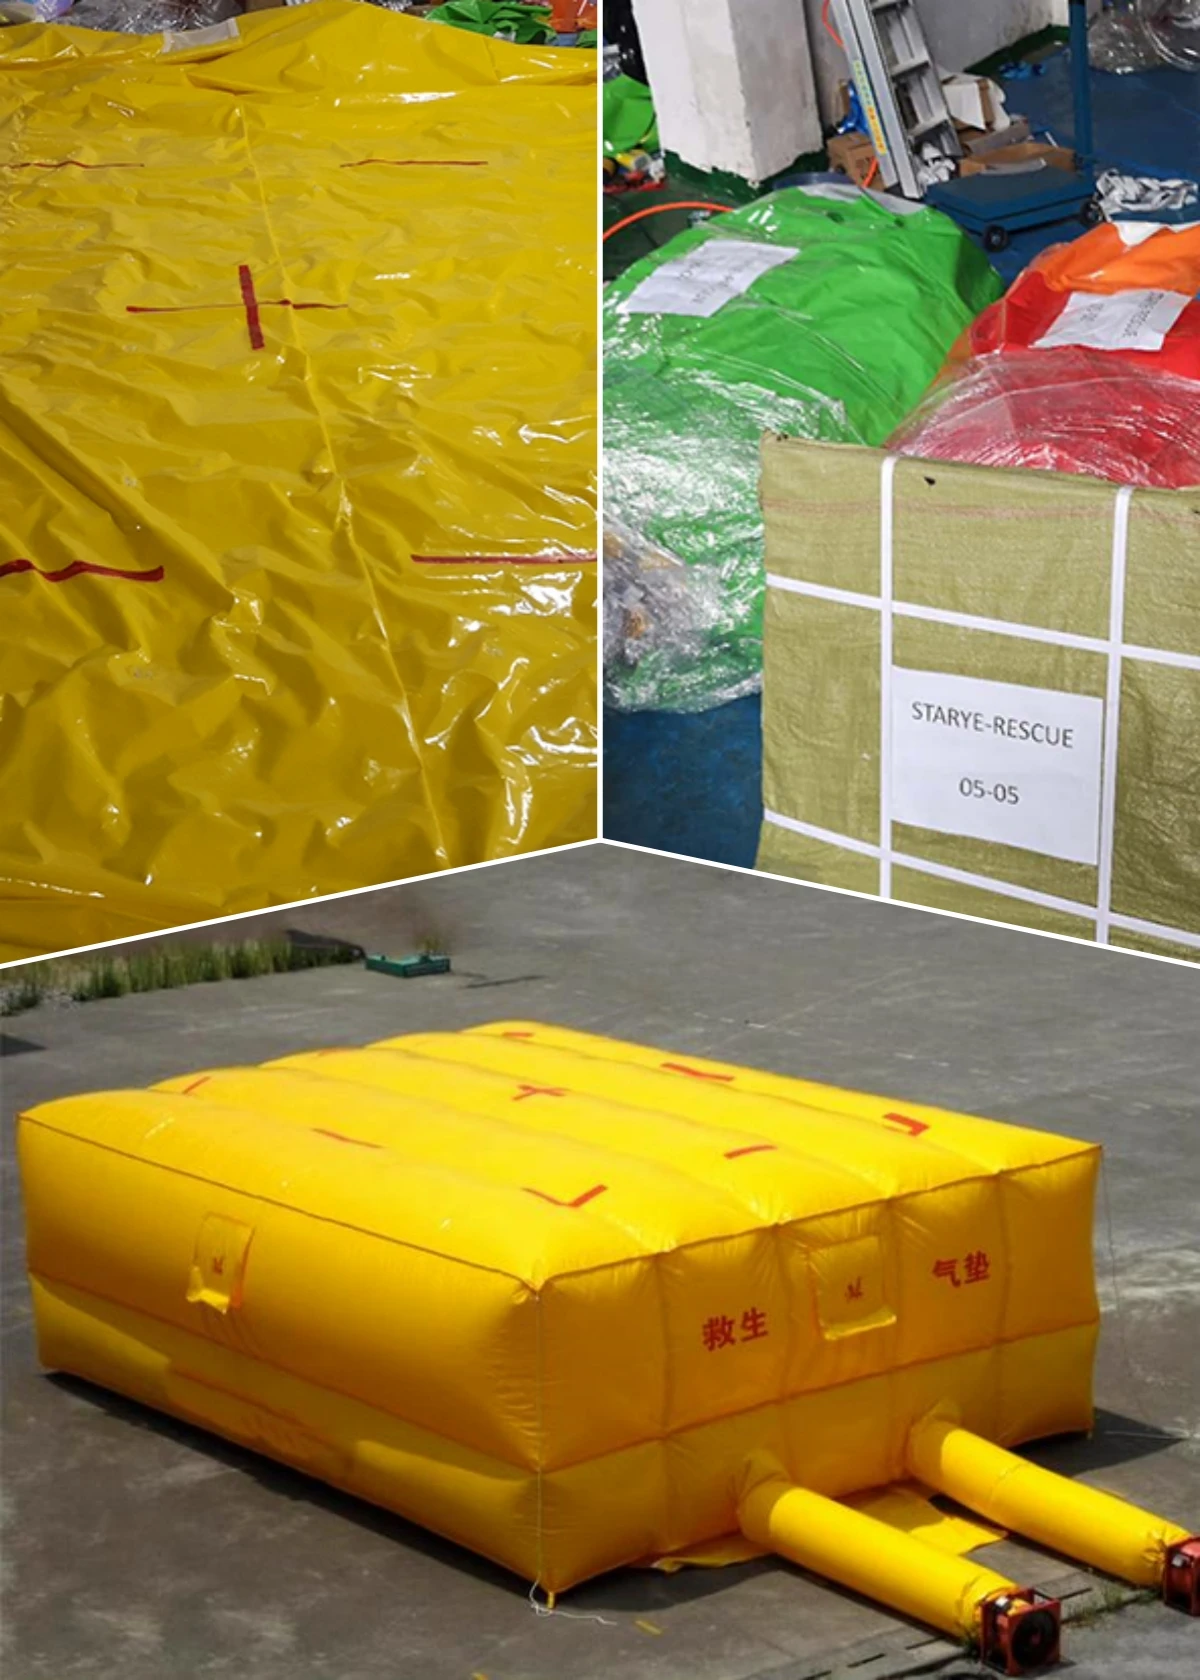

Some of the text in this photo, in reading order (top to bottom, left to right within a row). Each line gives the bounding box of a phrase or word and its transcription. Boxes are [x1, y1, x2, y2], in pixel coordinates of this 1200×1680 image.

[911, 701, 1074, 748] STARYE-RESCUE
[959, 777, 1020, 805] 05-05
[702, 1251, 991, 1351] 救生 气垫
